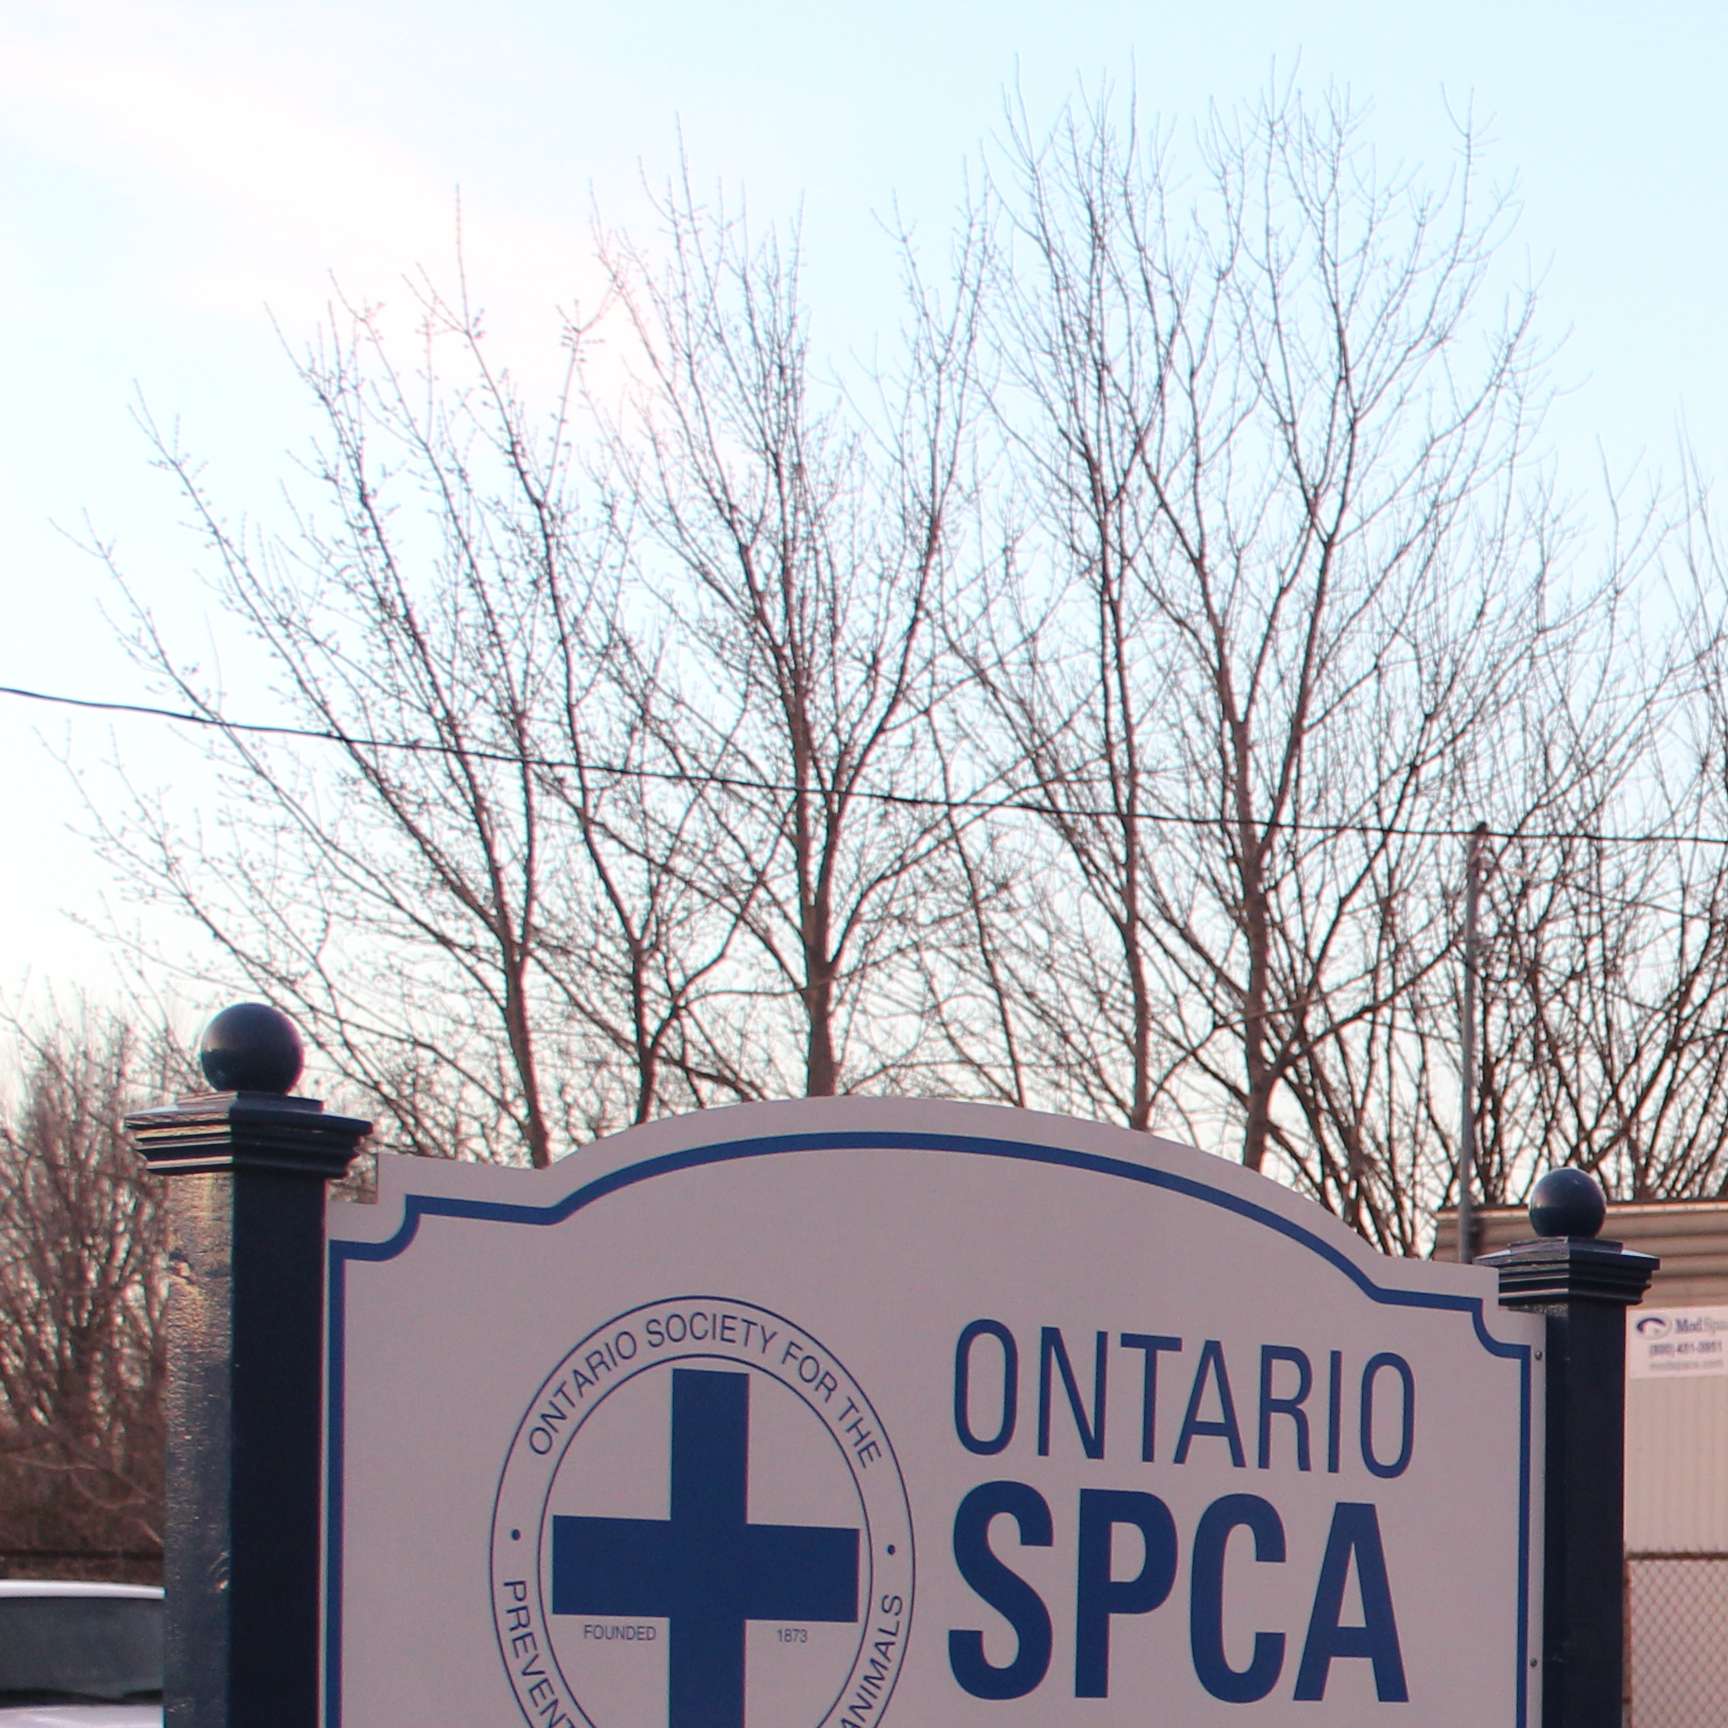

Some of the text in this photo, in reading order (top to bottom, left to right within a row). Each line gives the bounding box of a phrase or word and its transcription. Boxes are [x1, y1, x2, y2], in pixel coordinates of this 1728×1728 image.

[528, 1311, 882, 1469] ONTARIO SOCIETY FOR THE
[952, 1318, 1415, 1479] ONTARIO
[583, 1624, 808, 1644] FOUNDED 1873
[947, 1479, 1409, 1704] SPCA
